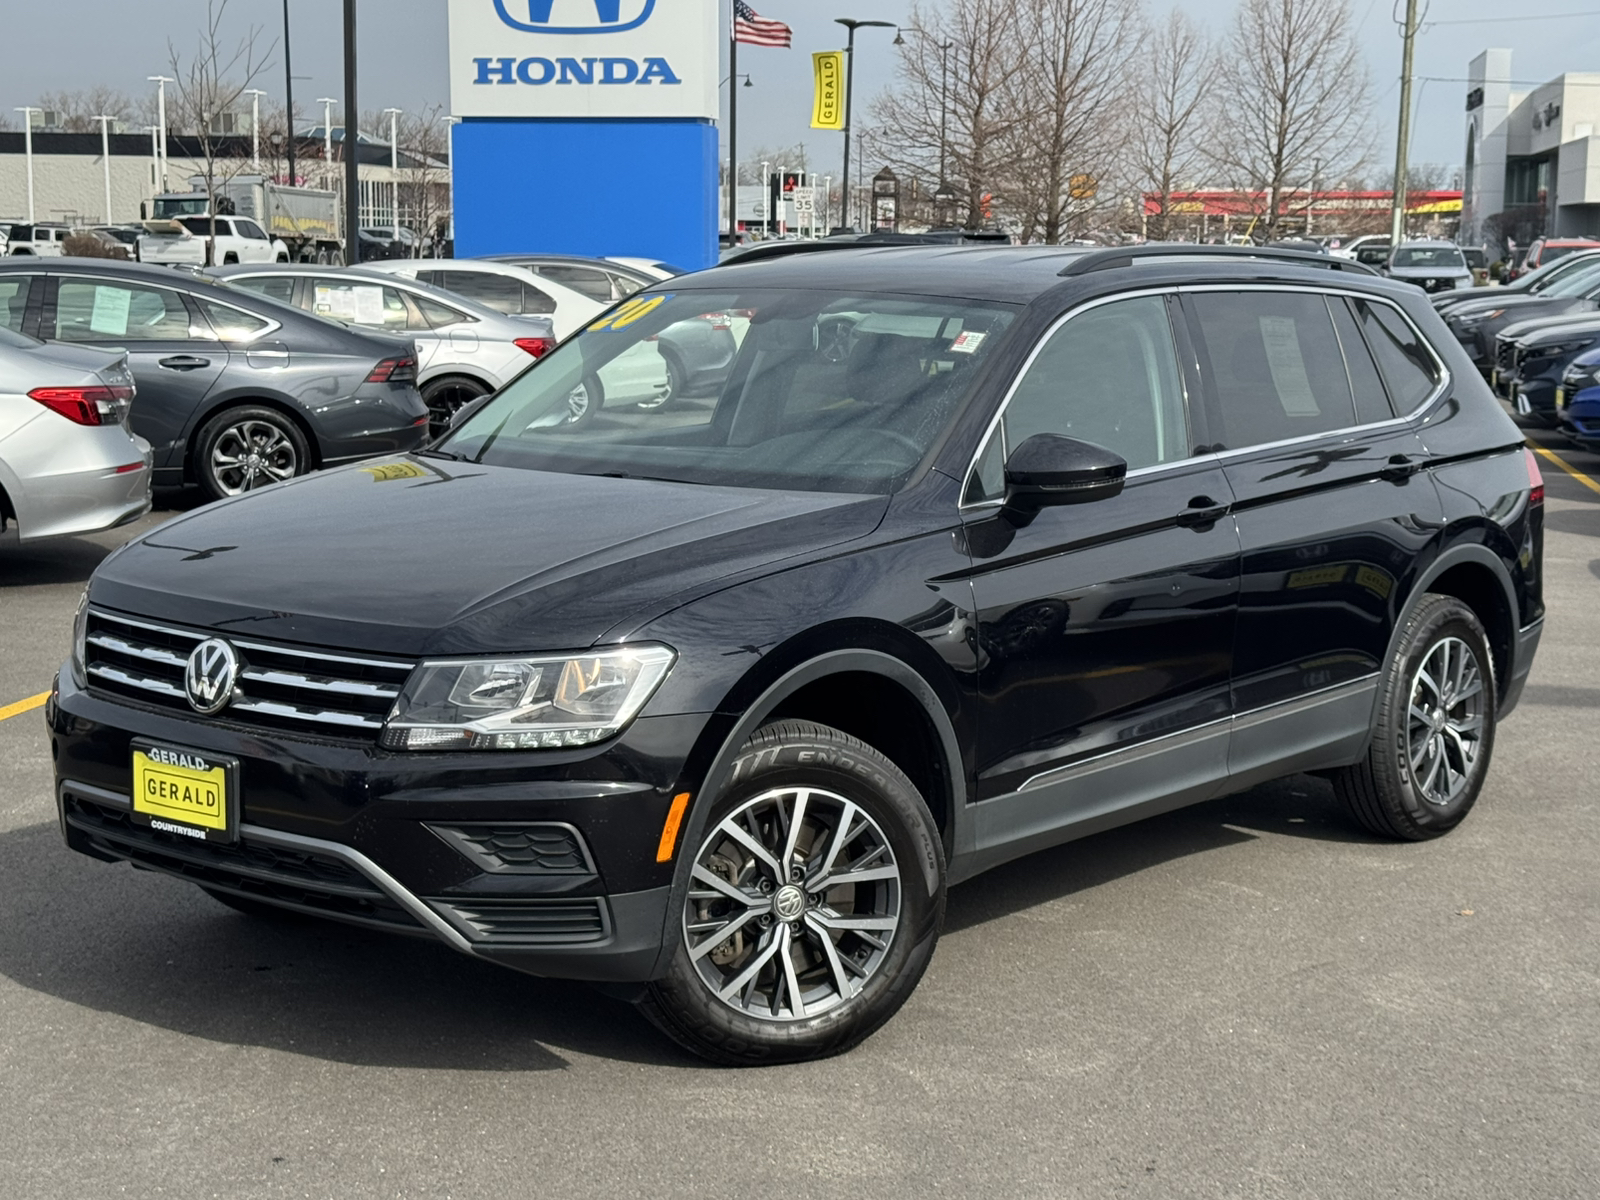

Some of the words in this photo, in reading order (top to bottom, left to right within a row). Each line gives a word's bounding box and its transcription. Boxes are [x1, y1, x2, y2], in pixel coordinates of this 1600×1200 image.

[472, 57, 682, 85] HONDA
[823, 61, 834, 119] GERALD
[796, 201, 812, 210] 35
[587, 295, 666, 332] 20
[150, 747, 205, 771] GERALD
[147, 778, 216, 808] GERALD
[797, 751, 922, 830] ENDEAVOR
[920, 833, 935, 870] PLUS
[151, 820, 206, 840] COUNTRYSIDE
